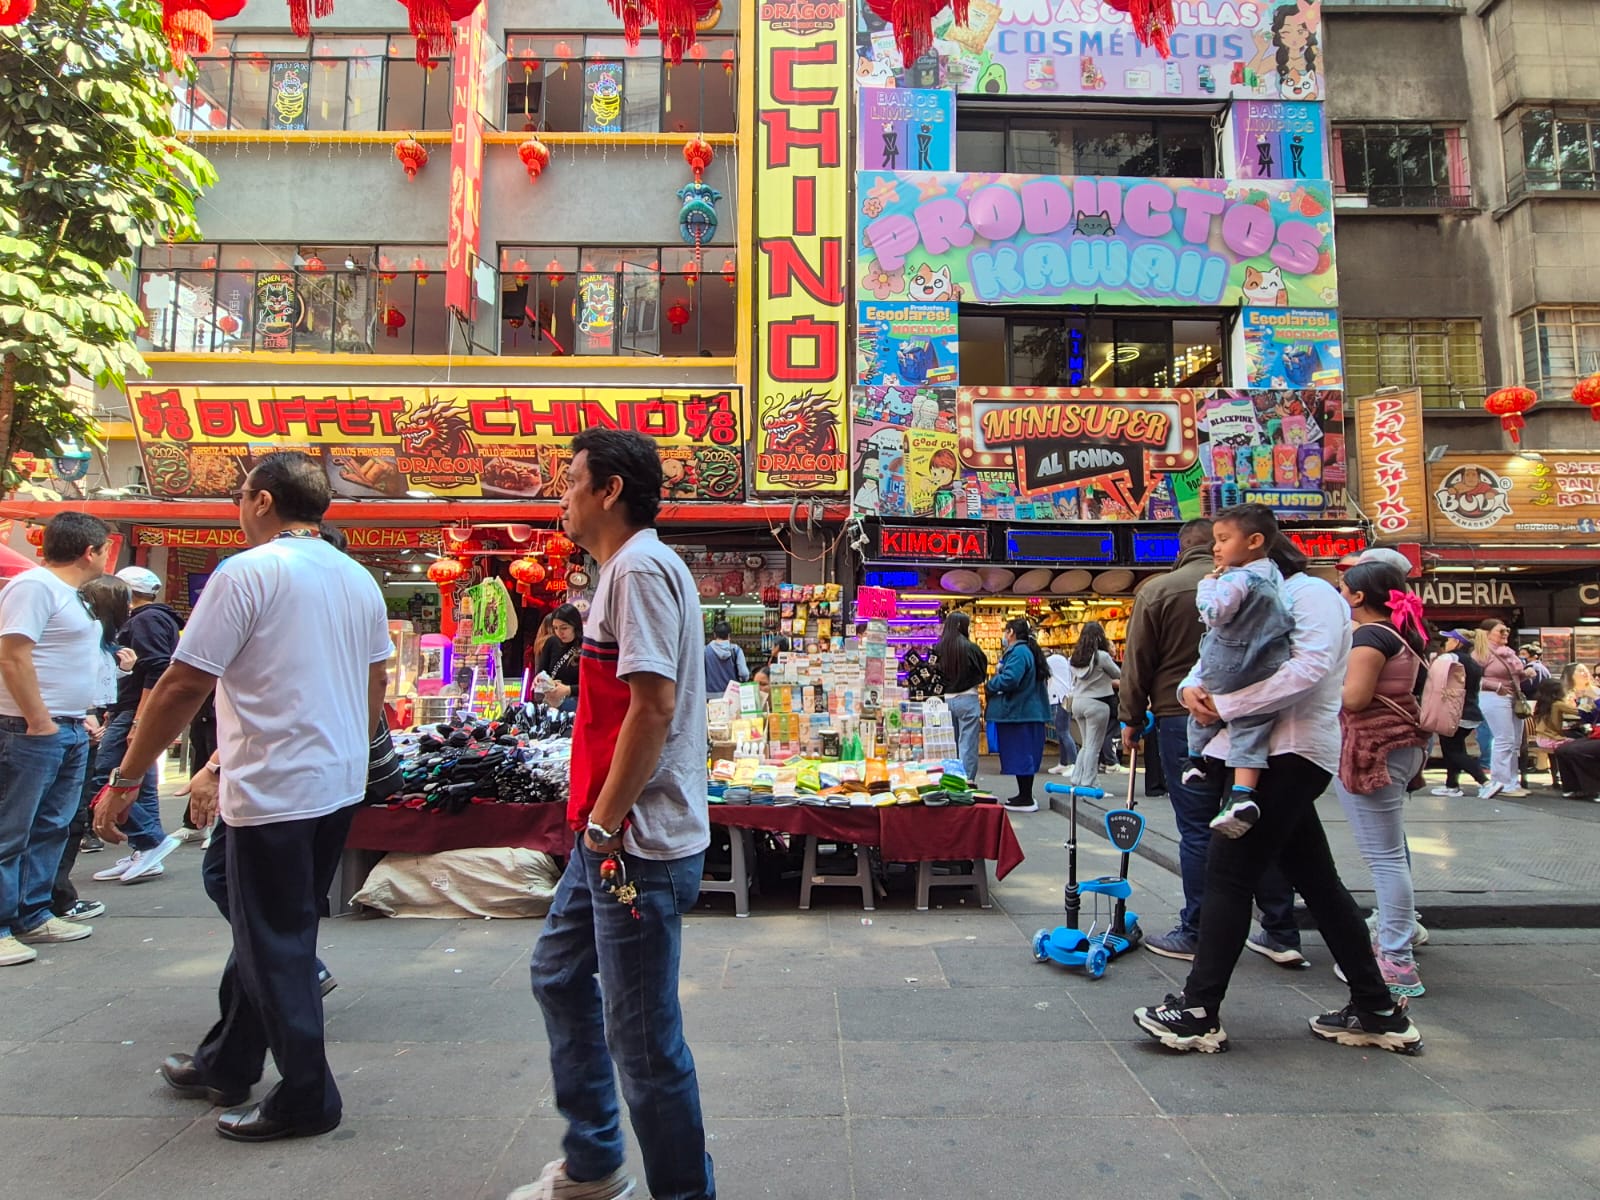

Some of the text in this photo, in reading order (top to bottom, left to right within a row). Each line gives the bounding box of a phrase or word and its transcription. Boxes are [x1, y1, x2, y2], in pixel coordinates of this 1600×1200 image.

[760, 3, 846, 20] DRAGON
[998, 0, 1260, 28] MASCILLAS
[998, 28, 1244, 61] COSMÉTCOS
[455, 26, 471, 144] HINO
[877, 91, 938, 108] BAÑOS
[871, 106, 945, 123] LIMPIOS
[1249, 104, 1308, 119] BAÑOS
[760, 40, 844, 382] CHINO
[866, 179, 1325, 276] PRODUCTOS
[970, 238, 1228, 304] KAWAII
[866, 306, 951, 321] Escolares!
[911, 304, 945, 312] Productos
[1250, 312, 1330, 327] Escolares!
[892, 325, 957, 335] MOCHILAS
[1275, 329, 1338, 340] MOCHILAS
[195, 396, 405, 437] BUFFET
[468, 396, 680, 436] CHINO
[983, 404, 1172, 445] MINISUPER
[1210, 414, 1254, 427] BLACKPINK
[154, 448, 180, 459] 2025
[705, 451, 731, 462] 2025
[399, 457, 484, 474] DRAGON
[758, 454, 847, 471] DRAGON
[1036, 452, 1064, 478] AL
[1069, 448, 1125, 471] FONDO
[1370, 399, 1411, 533] PAN CHINO
[966, 487, 980, 517] PRIME
[1245, 492, 1323, 507] PASE USTED
[342, 530, 408, 546] ANCHA
[882, 532, 981, 555] KIMODA
[1405, 577, 1516, 605] NADERÍA
